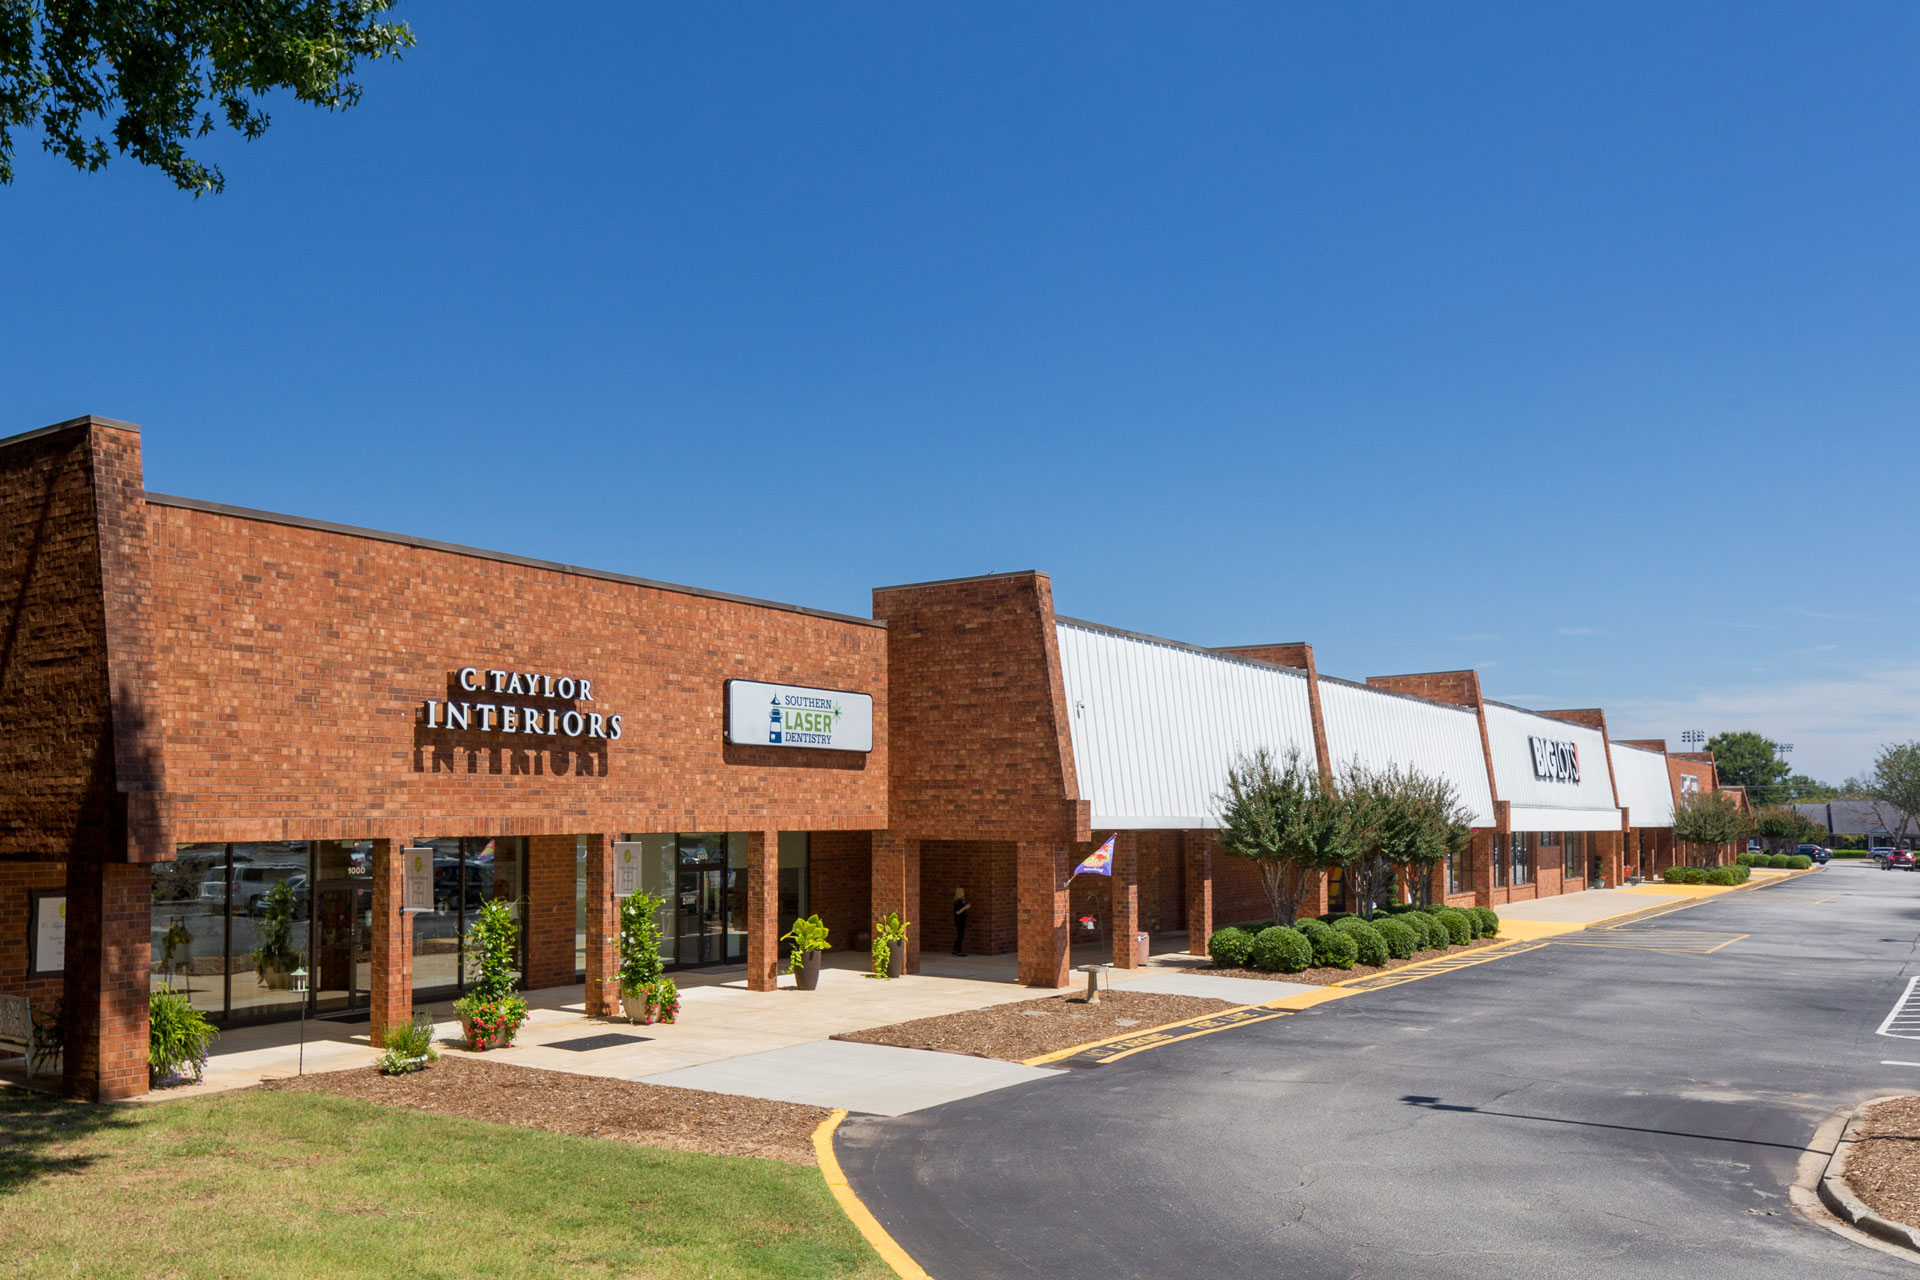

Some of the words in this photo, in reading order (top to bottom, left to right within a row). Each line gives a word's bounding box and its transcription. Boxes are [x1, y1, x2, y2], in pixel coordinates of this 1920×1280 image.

[459, 667, 486, 691] C.
[489, 670, 594, 701] TAYLOR
[785, 695, 832, 709] SOUTHERN
[427, 700, 622, 740] INTERIORS
[785, 711, 832, 733] LASER
[785, 731, 832, 744] DENTISTRY
[1531, 736, 1557, 779] BIG
[347, 866, 366, 875] 1000
[1081, 1047, 1116, 1058] NO
[1108, 1032, 1174, 1050] PARKING
[1187, 1019, 1226, 1030] FIRE
[1217, 1012, 1259, 1022] LANE
